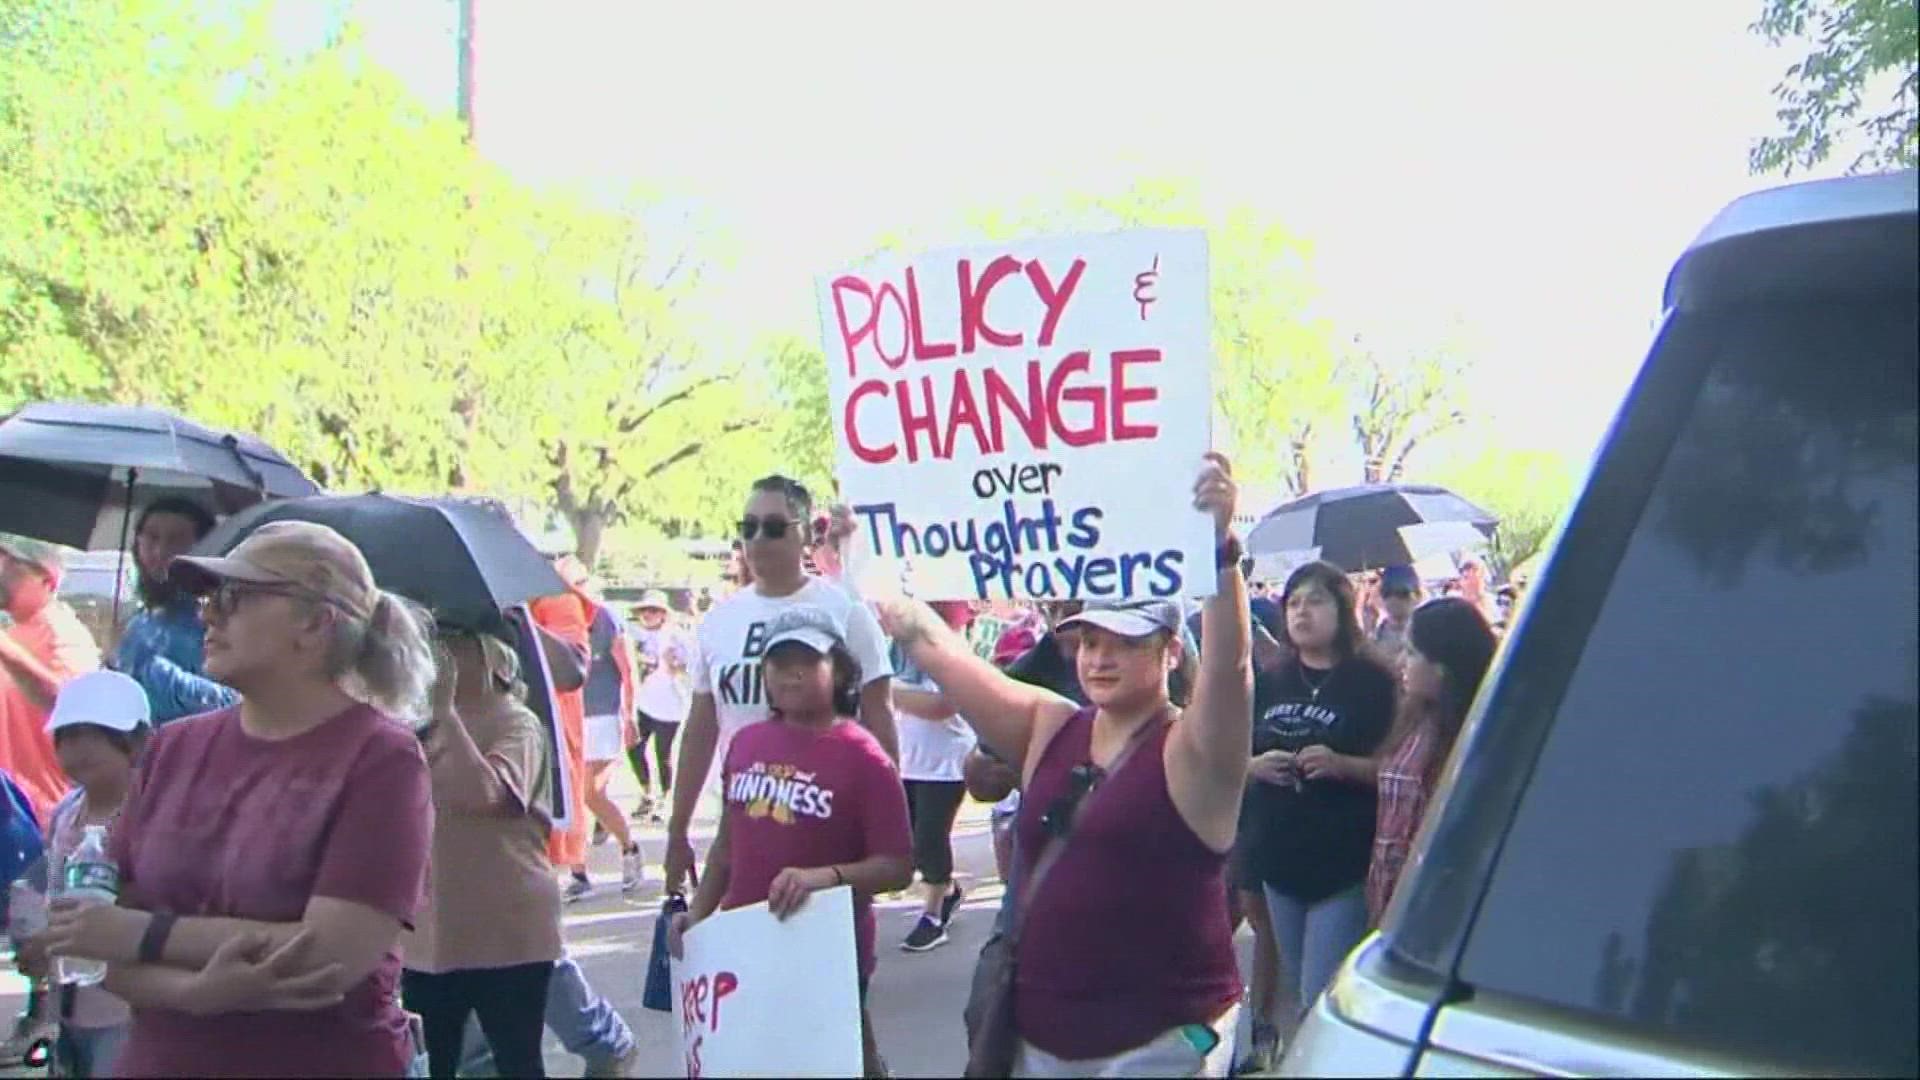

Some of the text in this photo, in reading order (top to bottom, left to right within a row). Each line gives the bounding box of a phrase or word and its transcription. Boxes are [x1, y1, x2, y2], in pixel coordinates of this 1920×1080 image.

[832, 252, 1159, 377] POLICY &
[845, 350, 1162, 463] CHANGE
[972, 462, 1062, 498] over
[853, 499, 1104, 558] Thoughts
[969, 550, 1184, 600] Prayers
[728, 772, 834, 820] KINDNESS
